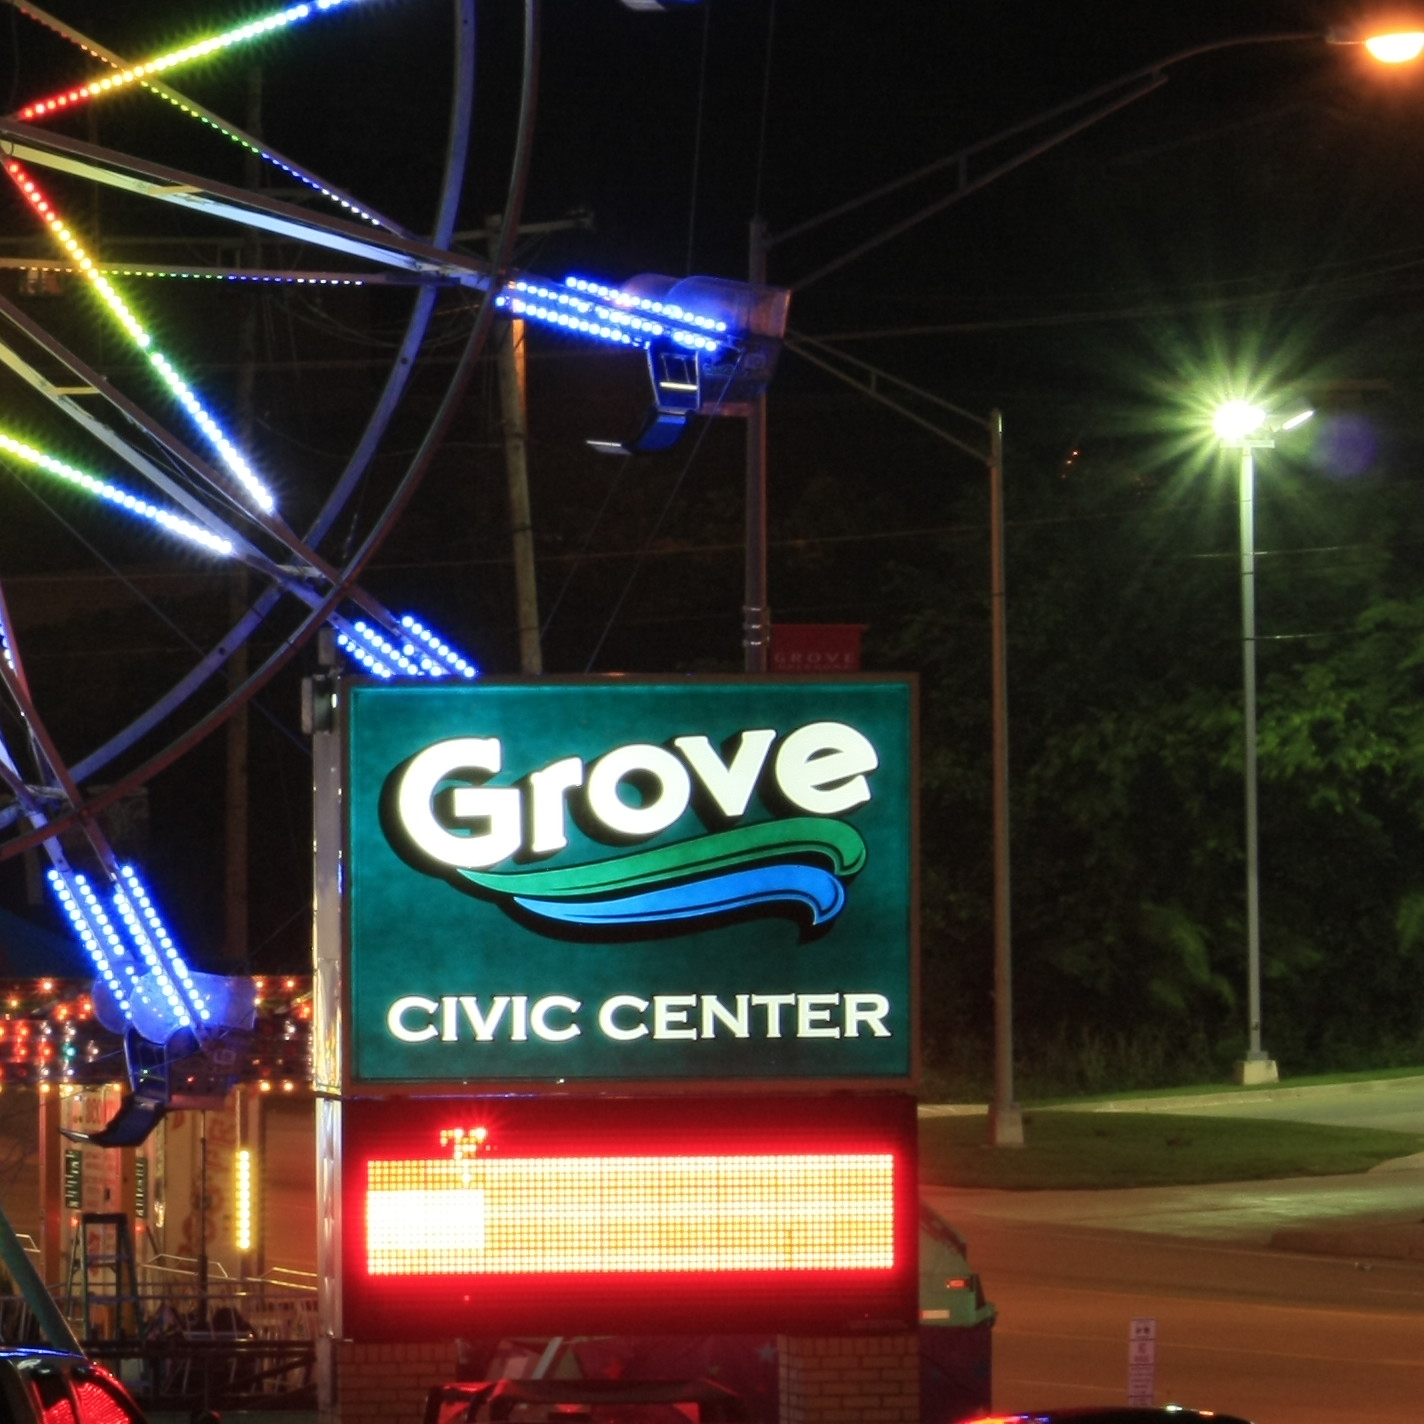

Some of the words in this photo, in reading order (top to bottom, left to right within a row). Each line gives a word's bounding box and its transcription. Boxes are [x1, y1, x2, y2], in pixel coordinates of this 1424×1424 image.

[774, 652, 854, 663] GROVE
[395, 720, 880, 869] Grove
[386, 994, 581, 1043] CIVIC
[599, 991, 891, 1042] CENTER
